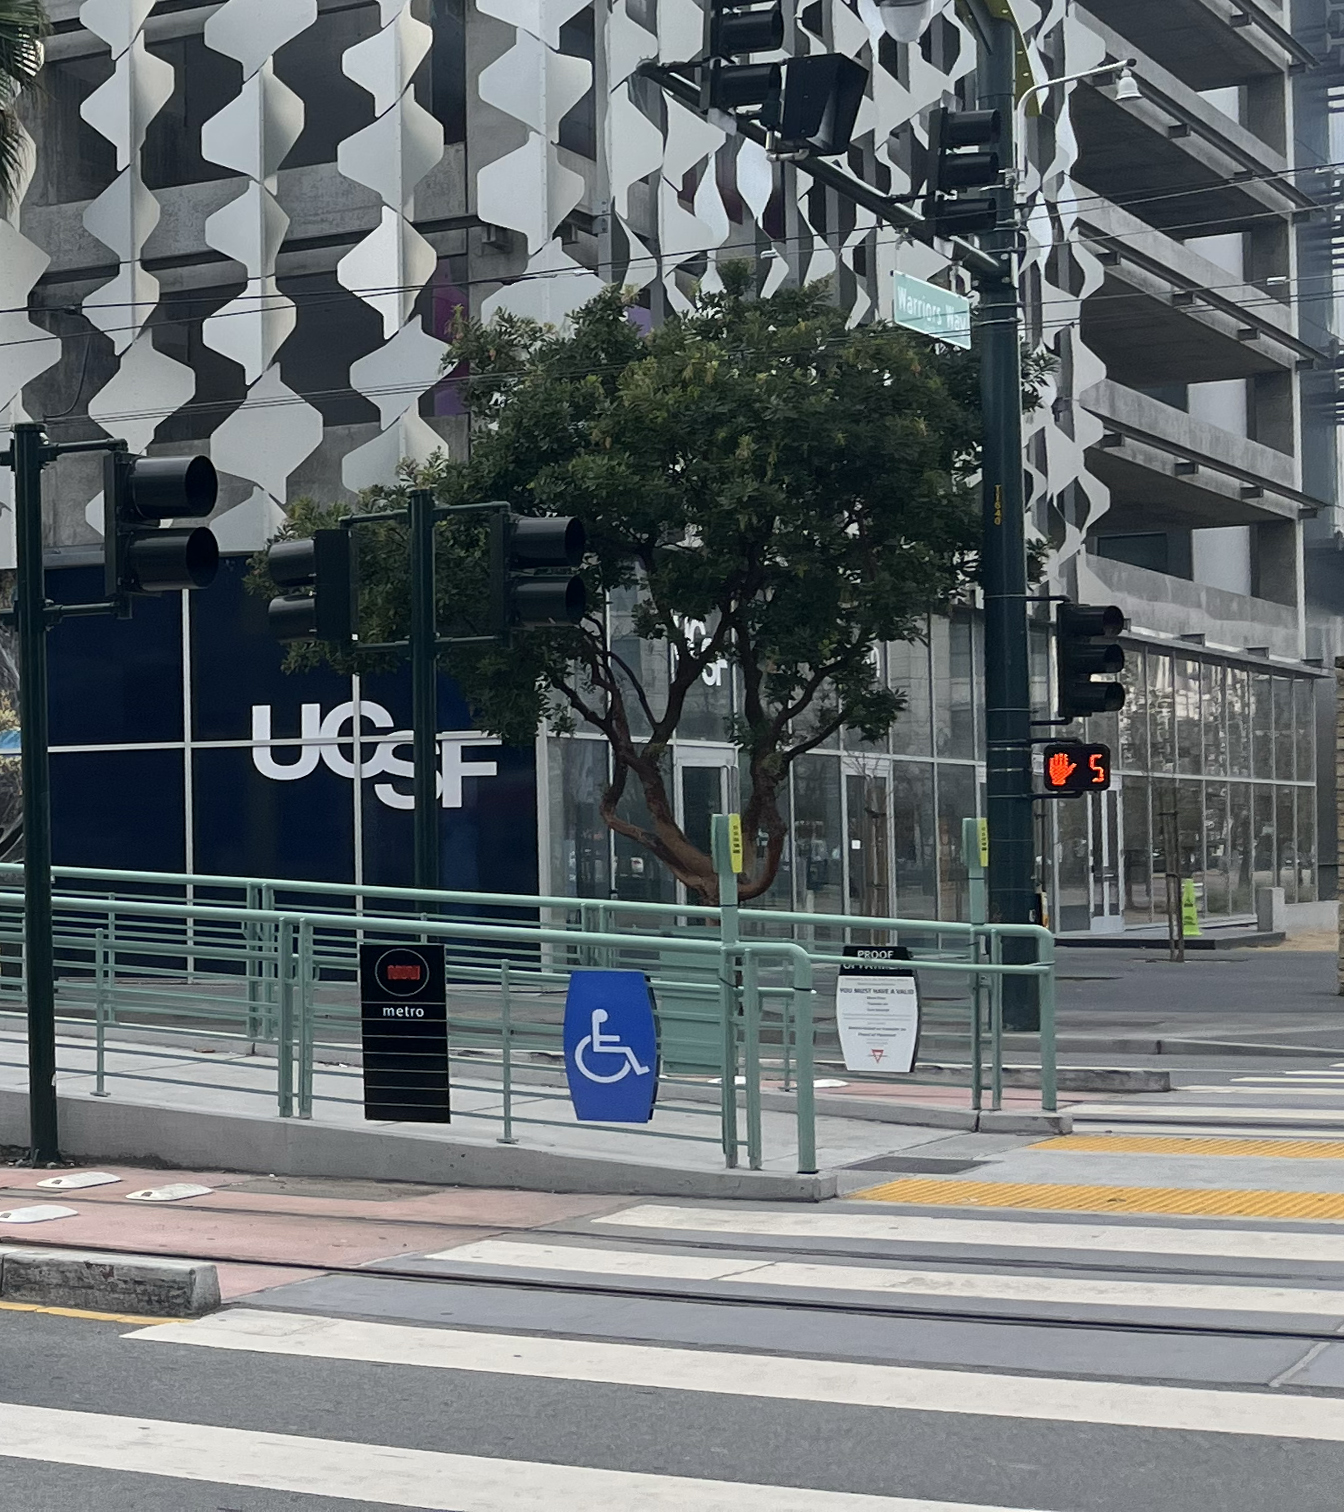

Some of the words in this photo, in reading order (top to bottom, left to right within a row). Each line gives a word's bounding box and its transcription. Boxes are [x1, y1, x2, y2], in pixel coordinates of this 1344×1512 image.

[897, 285, 942, 326] Warriors
[252, 700, 503, 809] UCSF
[1088, 753, 1105, 783] 5
[857, 950, 894, 959] PROOF
[382, 1006, 424, 1017] metro
